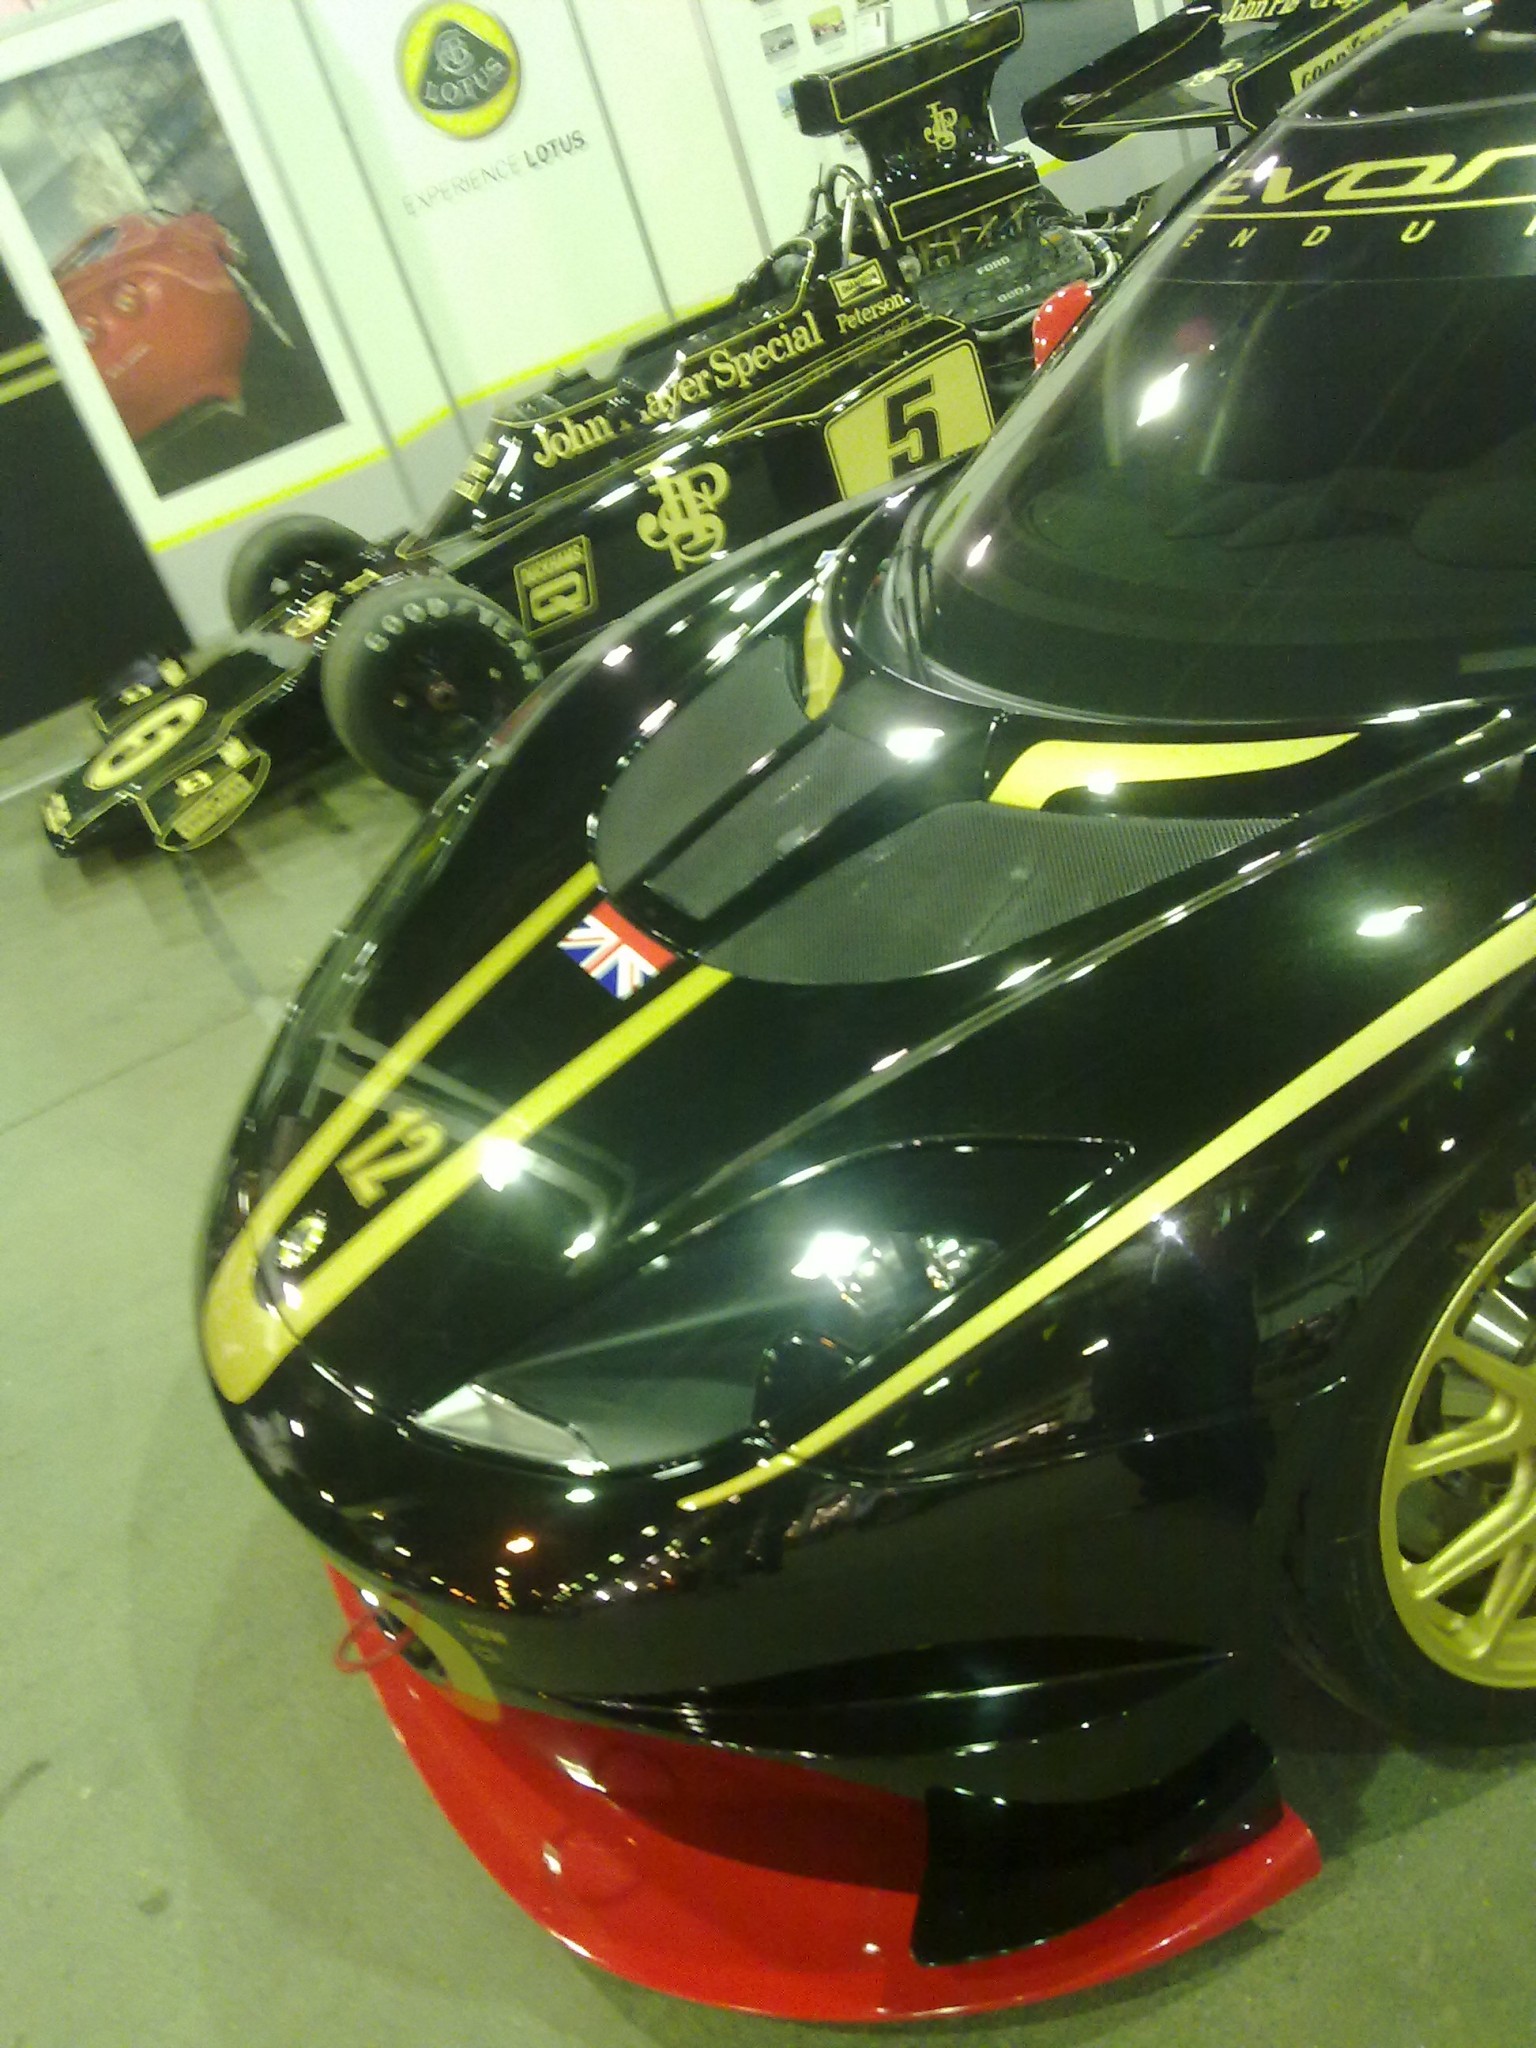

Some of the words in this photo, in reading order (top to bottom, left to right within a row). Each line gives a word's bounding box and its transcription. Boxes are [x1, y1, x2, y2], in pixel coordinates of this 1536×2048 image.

[424, 57, 506, 106] LOTUS
[402, 153, 521, 216] EXPERIENCE
[523, 129, 587, 169] LOTUS
[976, 255, 1011, 276] FORD
[834, 292, 907, 334] Peterson
[532, 415, 618, 469] John
[621, 369, 712, 432] ayer
[709, 310, 826, 392] Special
[884, 374, 945, 480] 5
[334, 1106, 445, 1209] 12
